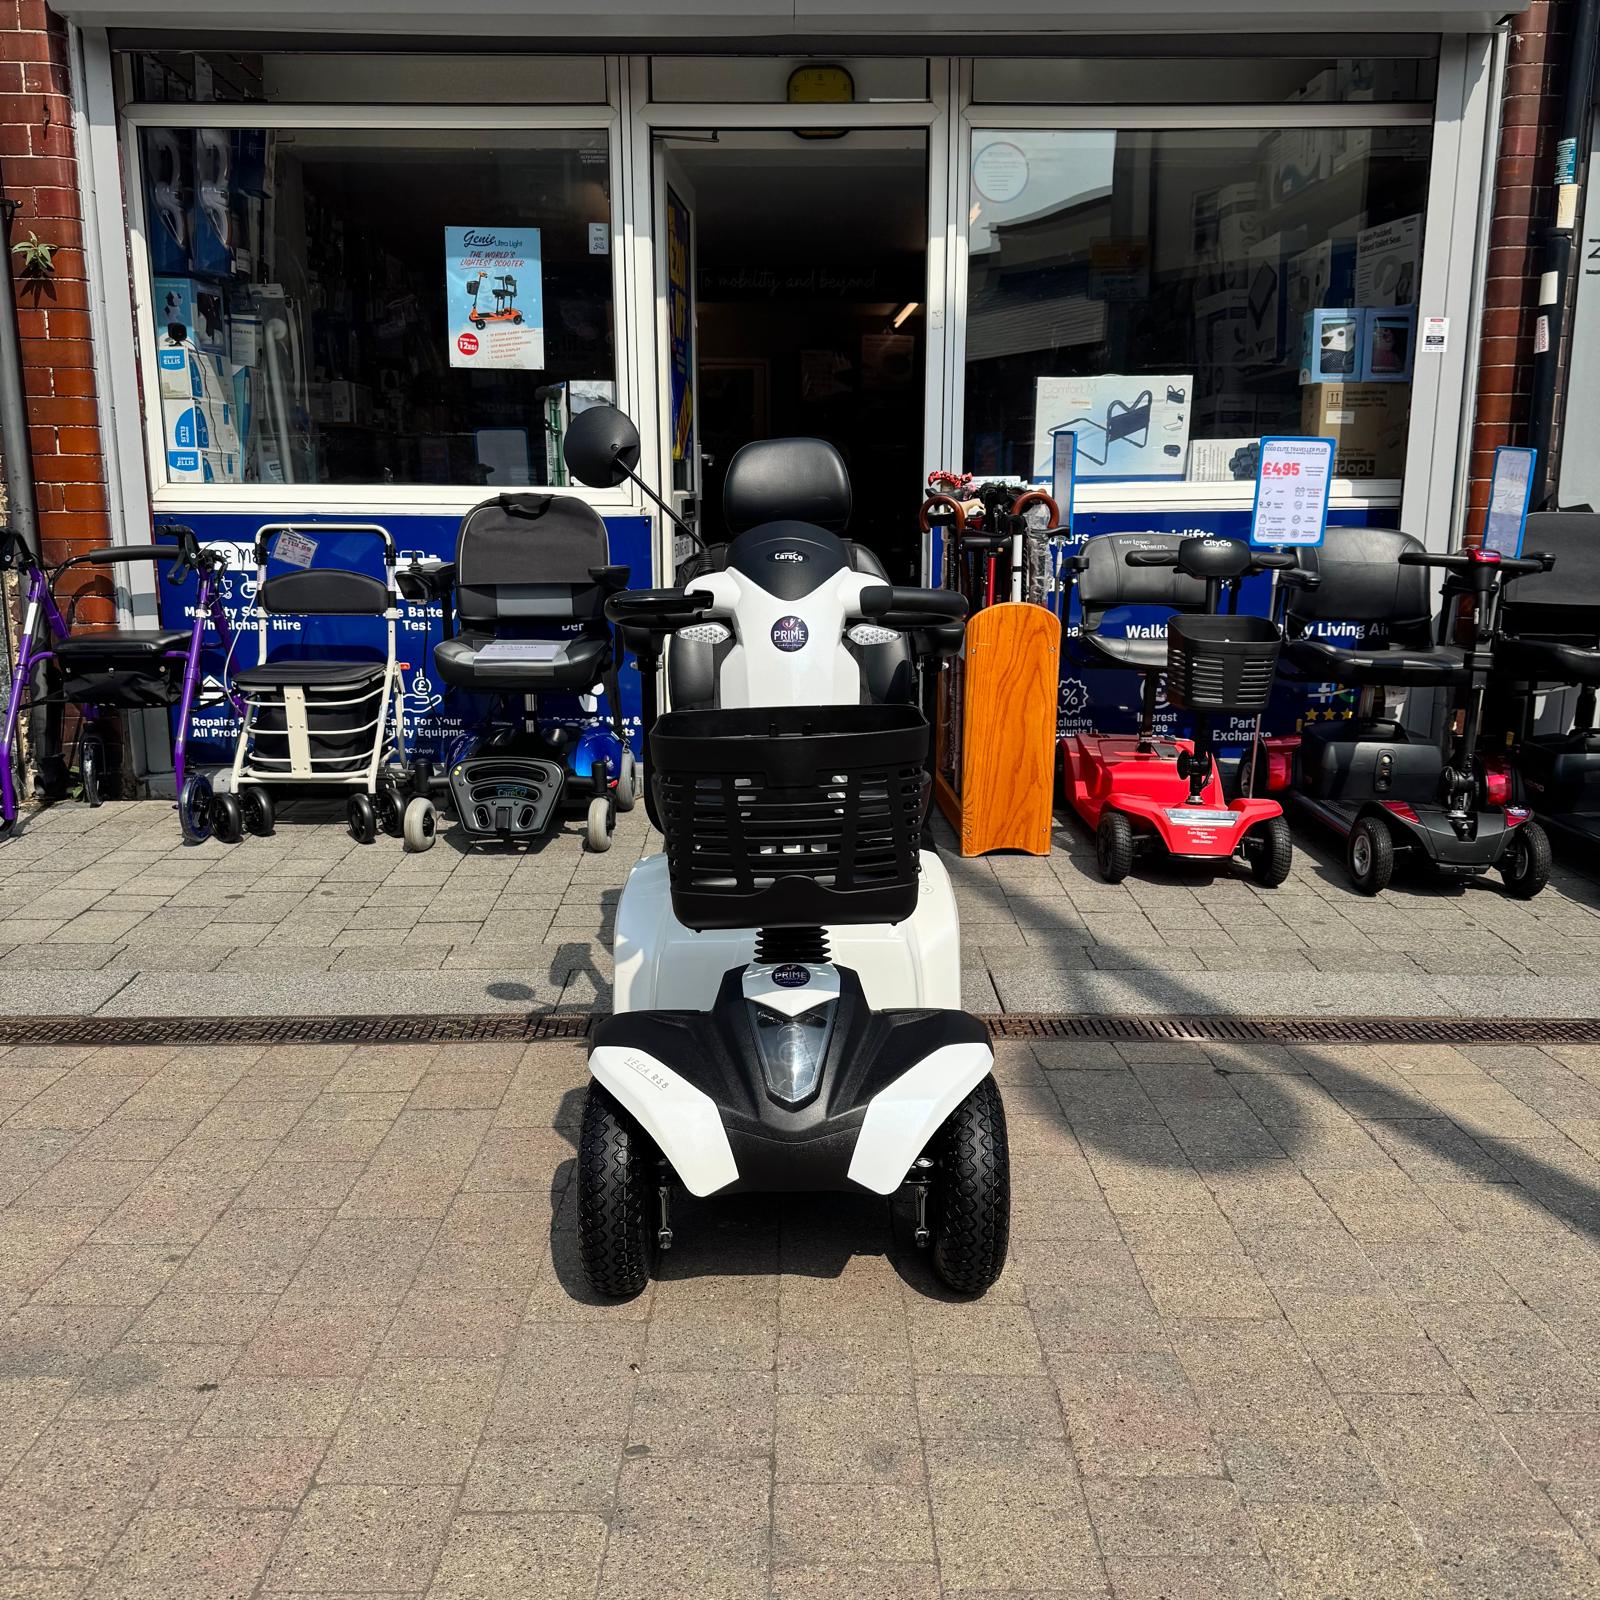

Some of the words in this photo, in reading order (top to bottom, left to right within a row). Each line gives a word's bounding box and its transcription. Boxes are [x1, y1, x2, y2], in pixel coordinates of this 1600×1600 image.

[463, 230, 495, 248] Genie
[509, 239, 523, 248] Light
[484, 250, 516, 258] WORLD'S
[460, 259, 492, 267] LIGHTEST
[495, 259, 525, 268] SCOOTER
[718, 264, 780, 297] mobility
[785, 265, 816, 294] and
[819, 264, 878, 297] beyond
[1262, 461, 1300, 476] £495
[1202, 539, 1232, 548] CityGo
[774, 552, 804, 562] CareCo
[407, 606, 457, 620] Battey
[273, 619, 302, 631] Hire
[402, 619, 432, 631] Test
[1317, 622, 1366, 640] Living
[1368, 622, 1389, 636] Ai
[773, 630, 806, 641] PRIME
[1126, 625, 1168, 639] Walki
[192, 717, 236, 729] Repairs
[385, 717, 411, 727] Cah
[413, 717, 433, 727] For
[606, 717, 630, 726] Nw
[632, 716, 642, 726] &
[1229, 716, 1257, 729] Part
[193, 728, 208, 738] All
[211, 728, 241, 738] Prod
[774, 971, 808, 979] PRIME
[626, 1056, 651, 1075] VEGA
